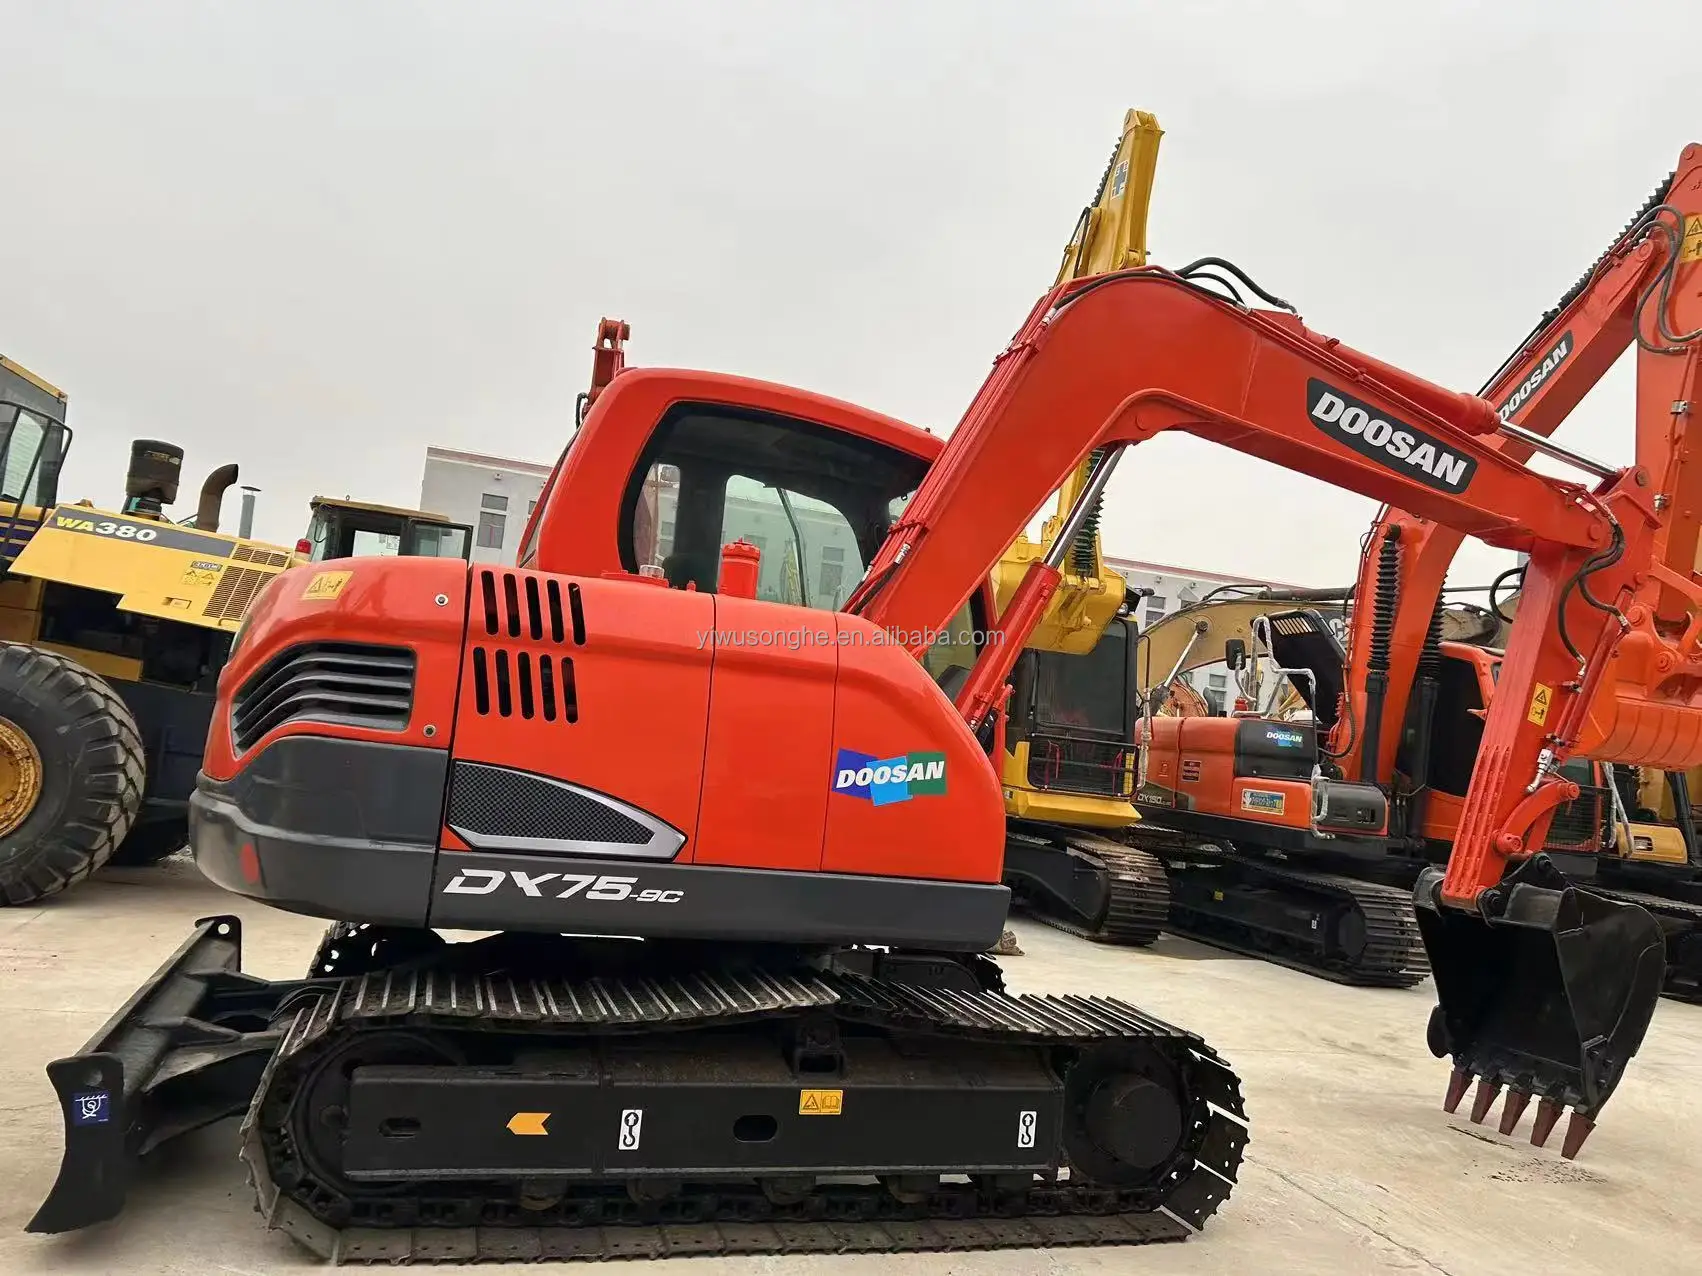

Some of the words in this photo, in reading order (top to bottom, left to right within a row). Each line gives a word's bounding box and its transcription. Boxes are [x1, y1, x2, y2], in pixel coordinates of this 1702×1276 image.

[1499, 341, 1567, 421] DOOSAN
[1311, 391, 1468, 486] DOOSAN
[56, 516, 157, 542] WA380
[1266, 731, 1303, 743] DOOSAN
[836, 760, 945, 789] DOOSAN
